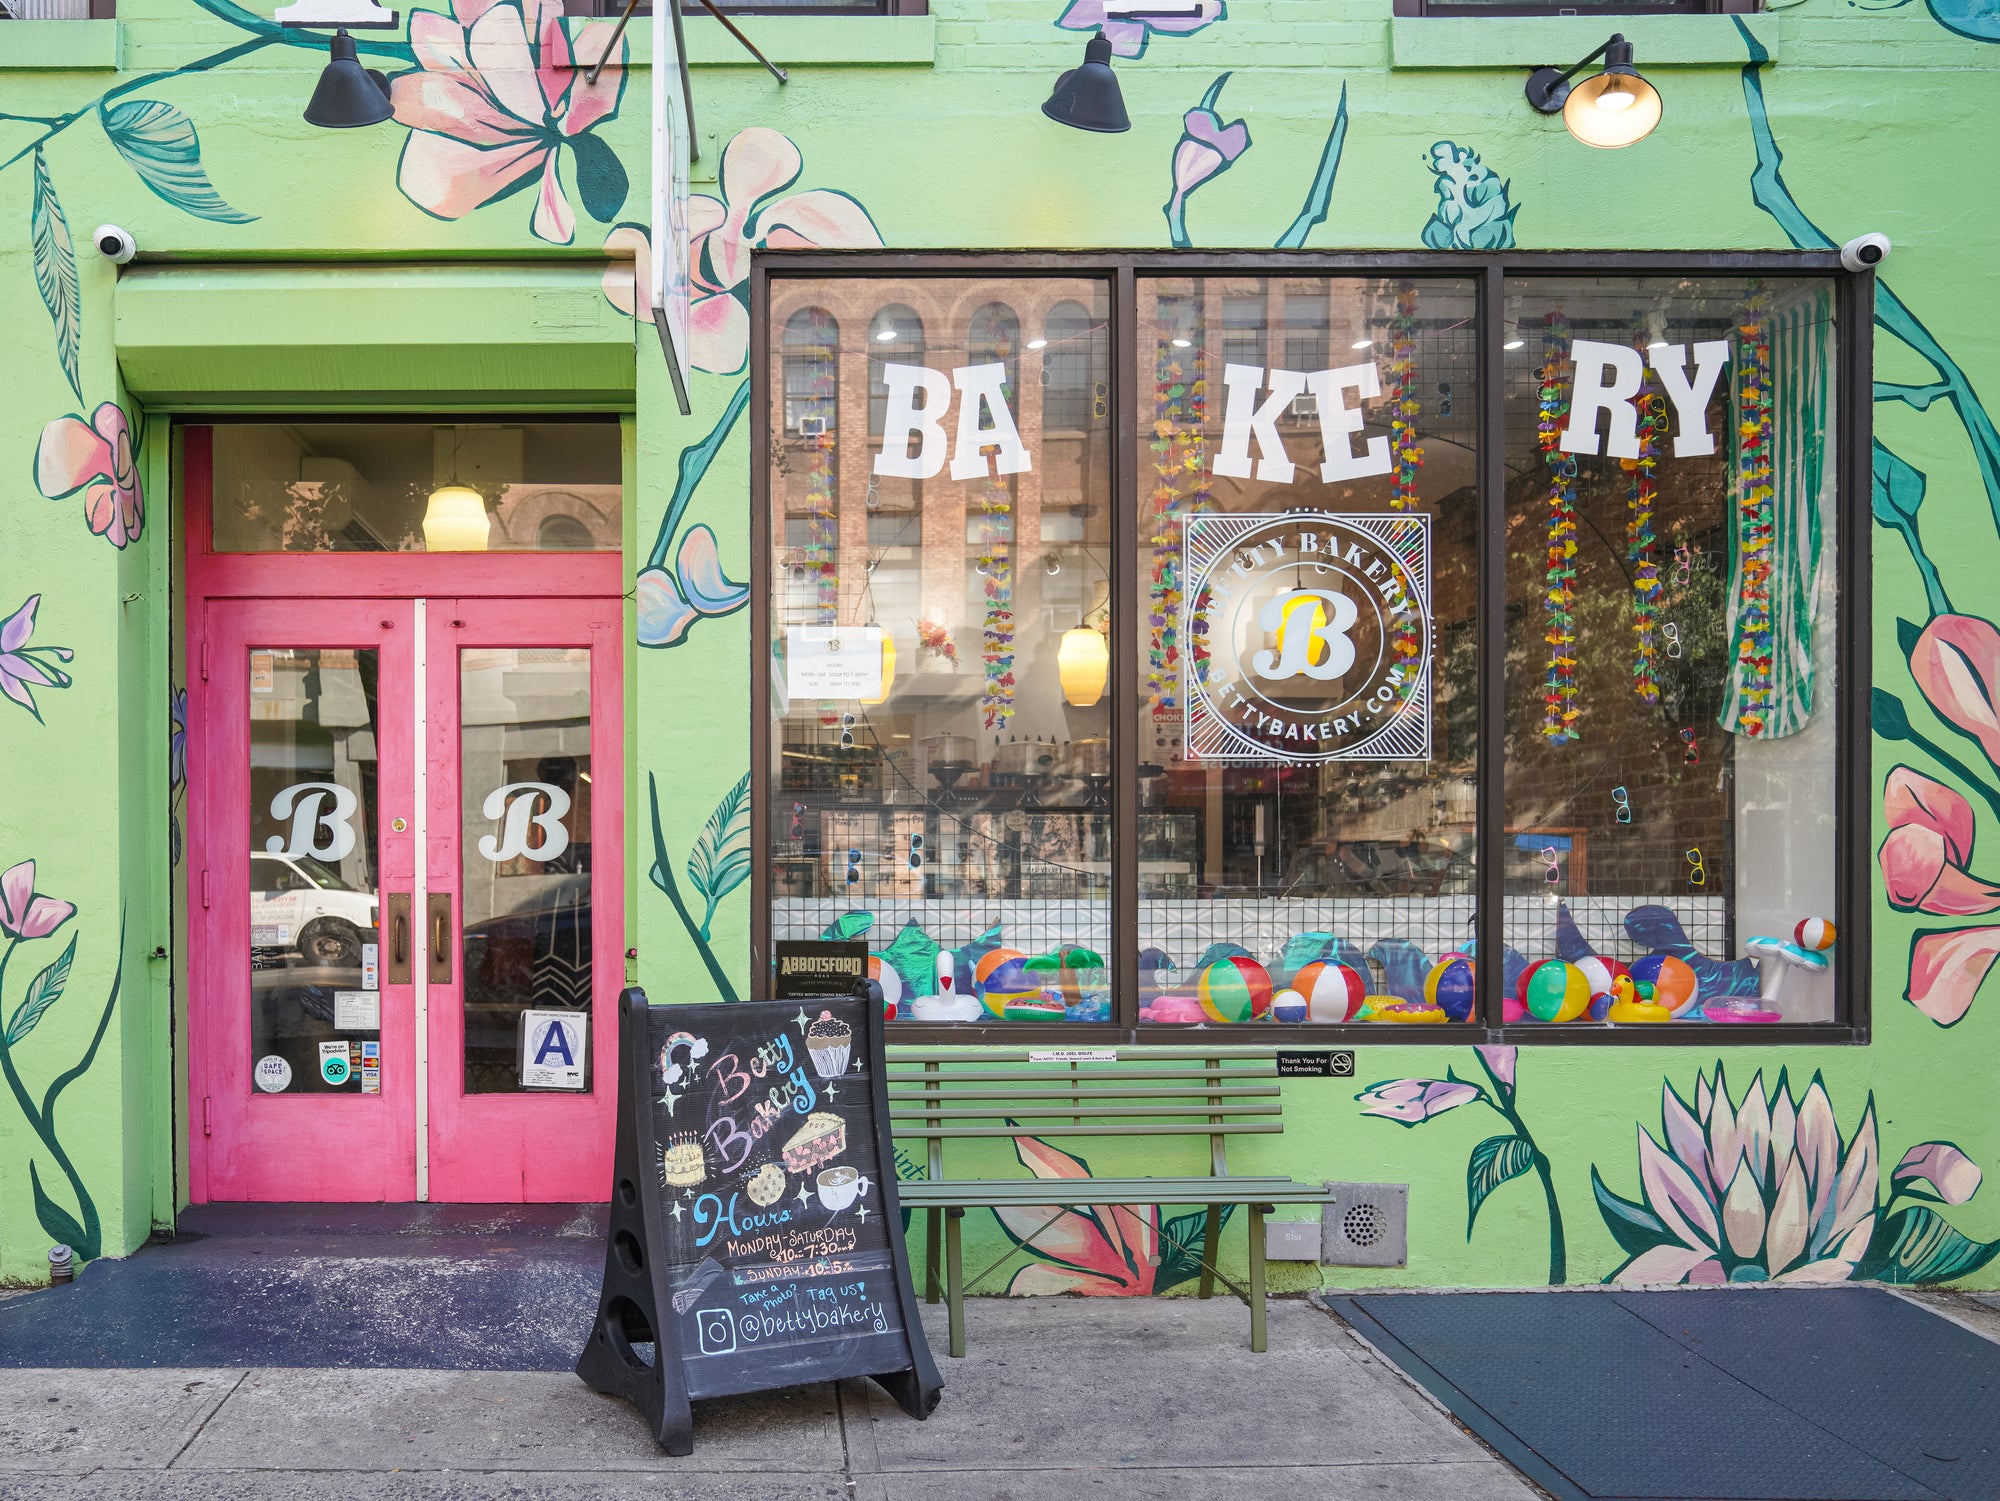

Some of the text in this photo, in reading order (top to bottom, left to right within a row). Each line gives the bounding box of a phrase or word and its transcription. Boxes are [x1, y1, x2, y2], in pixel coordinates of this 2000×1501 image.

[1206, 532, 1412, 619] BETTY BAKERY
[1252, 589, 1358, 680] B
[1210, 666, 1406, 741] BETTYBAKERY.COM
[265, 782, 358, 862] B
[478, 781, 571, 862] B
[781, 956, 862, 976] ABBOTSFORD
[534, 1021, 574, 1066] A
[706, 1033, 794, 1106] Betty
[703, 1066, 816, 1174] Bakery
[693, 1191, 793, 1247] Hours:
[740, 1284, 779, 1306] Take a
[740, 1302, 889, 1342] @bettybakery
[806, 1281, 867, 1304] Tag us!
